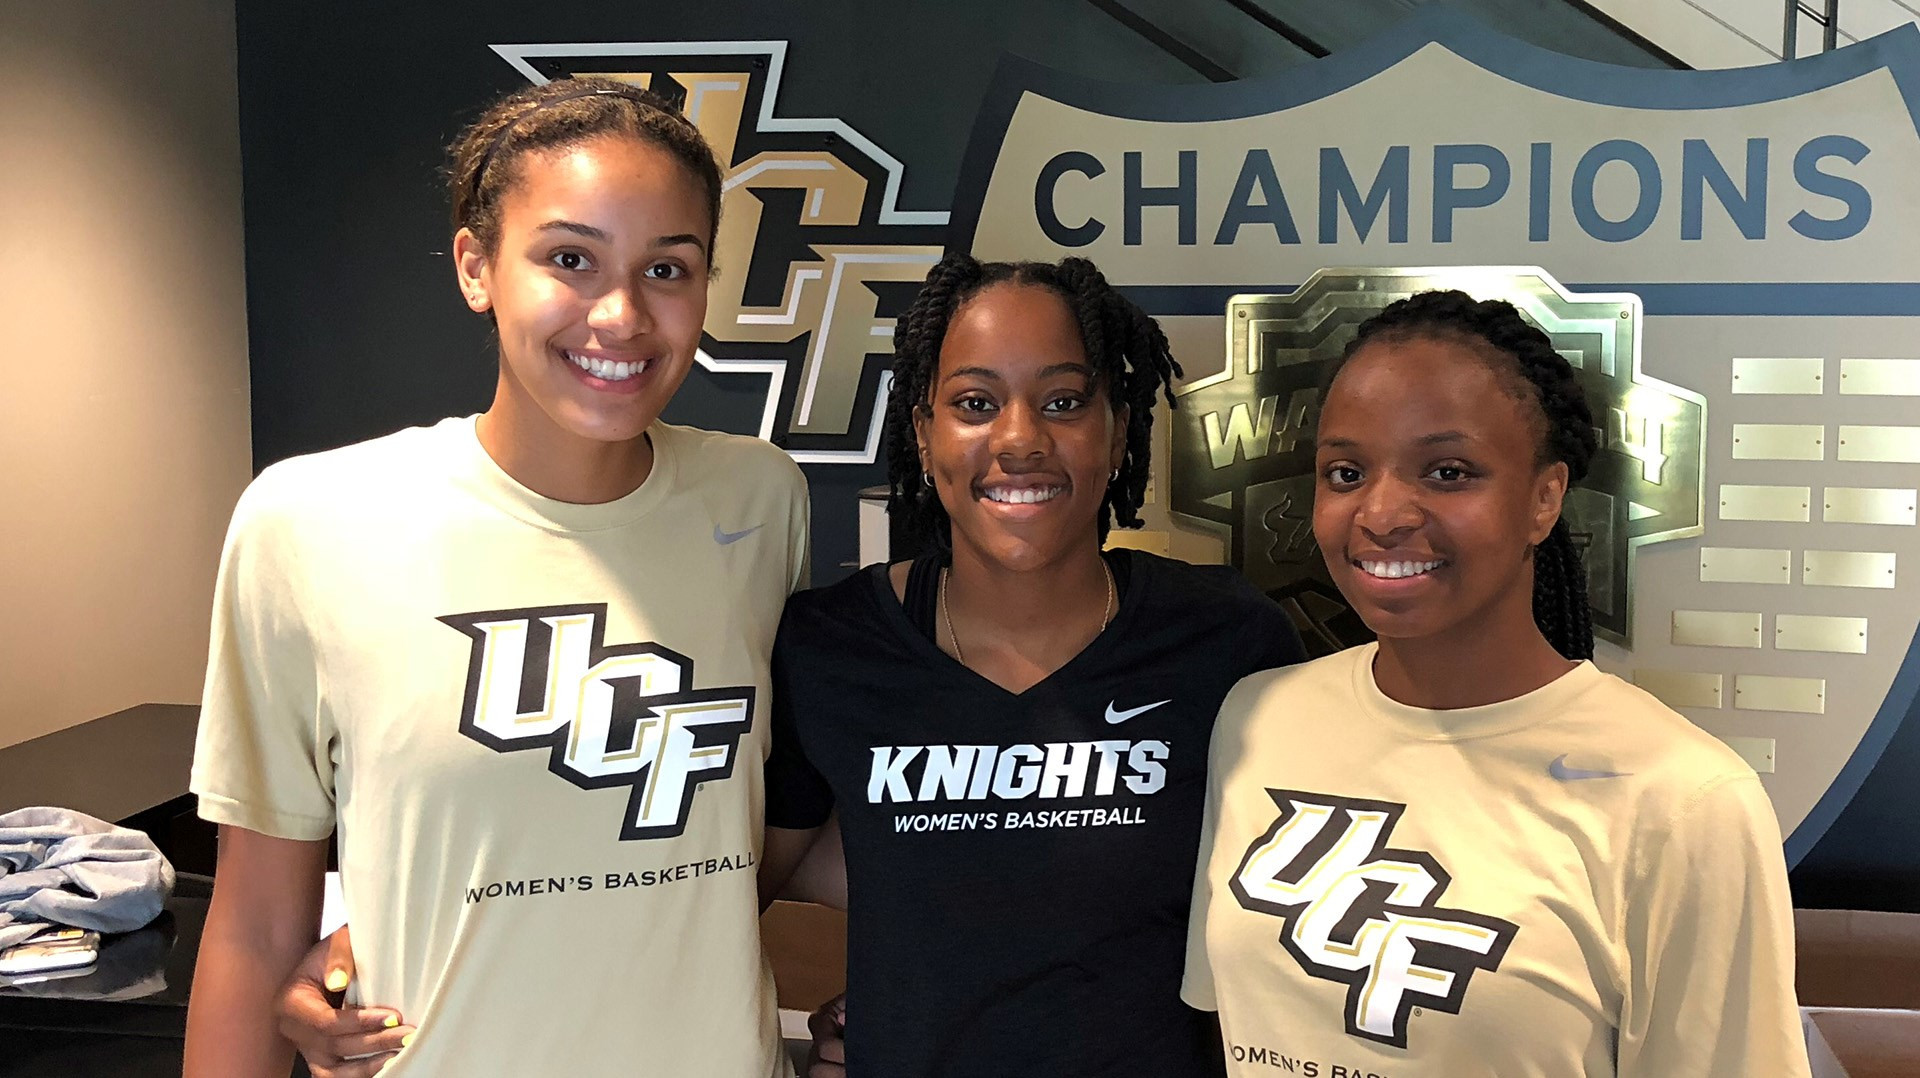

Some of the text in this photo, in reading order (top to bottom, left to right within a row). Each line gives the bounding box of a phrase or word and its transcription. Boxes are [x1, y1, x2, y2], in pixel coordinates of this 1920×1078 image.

[1034, 134, 1874, 247] CHAMPIONS
[1201, 387, 1320, 470] WA
[434, 602, 756, 841] UCF
[867, 740, 1170, 804] KNIGHTS
[894, 807, 1146, 832] WOMEN'S BASKETBALL
[465, 851, 755, 904] WOMEN'S BASKETBALL
[1228, 787, 1520, 1050] UCF
[1229, 1041, 1319, 1078] OMEN'S
